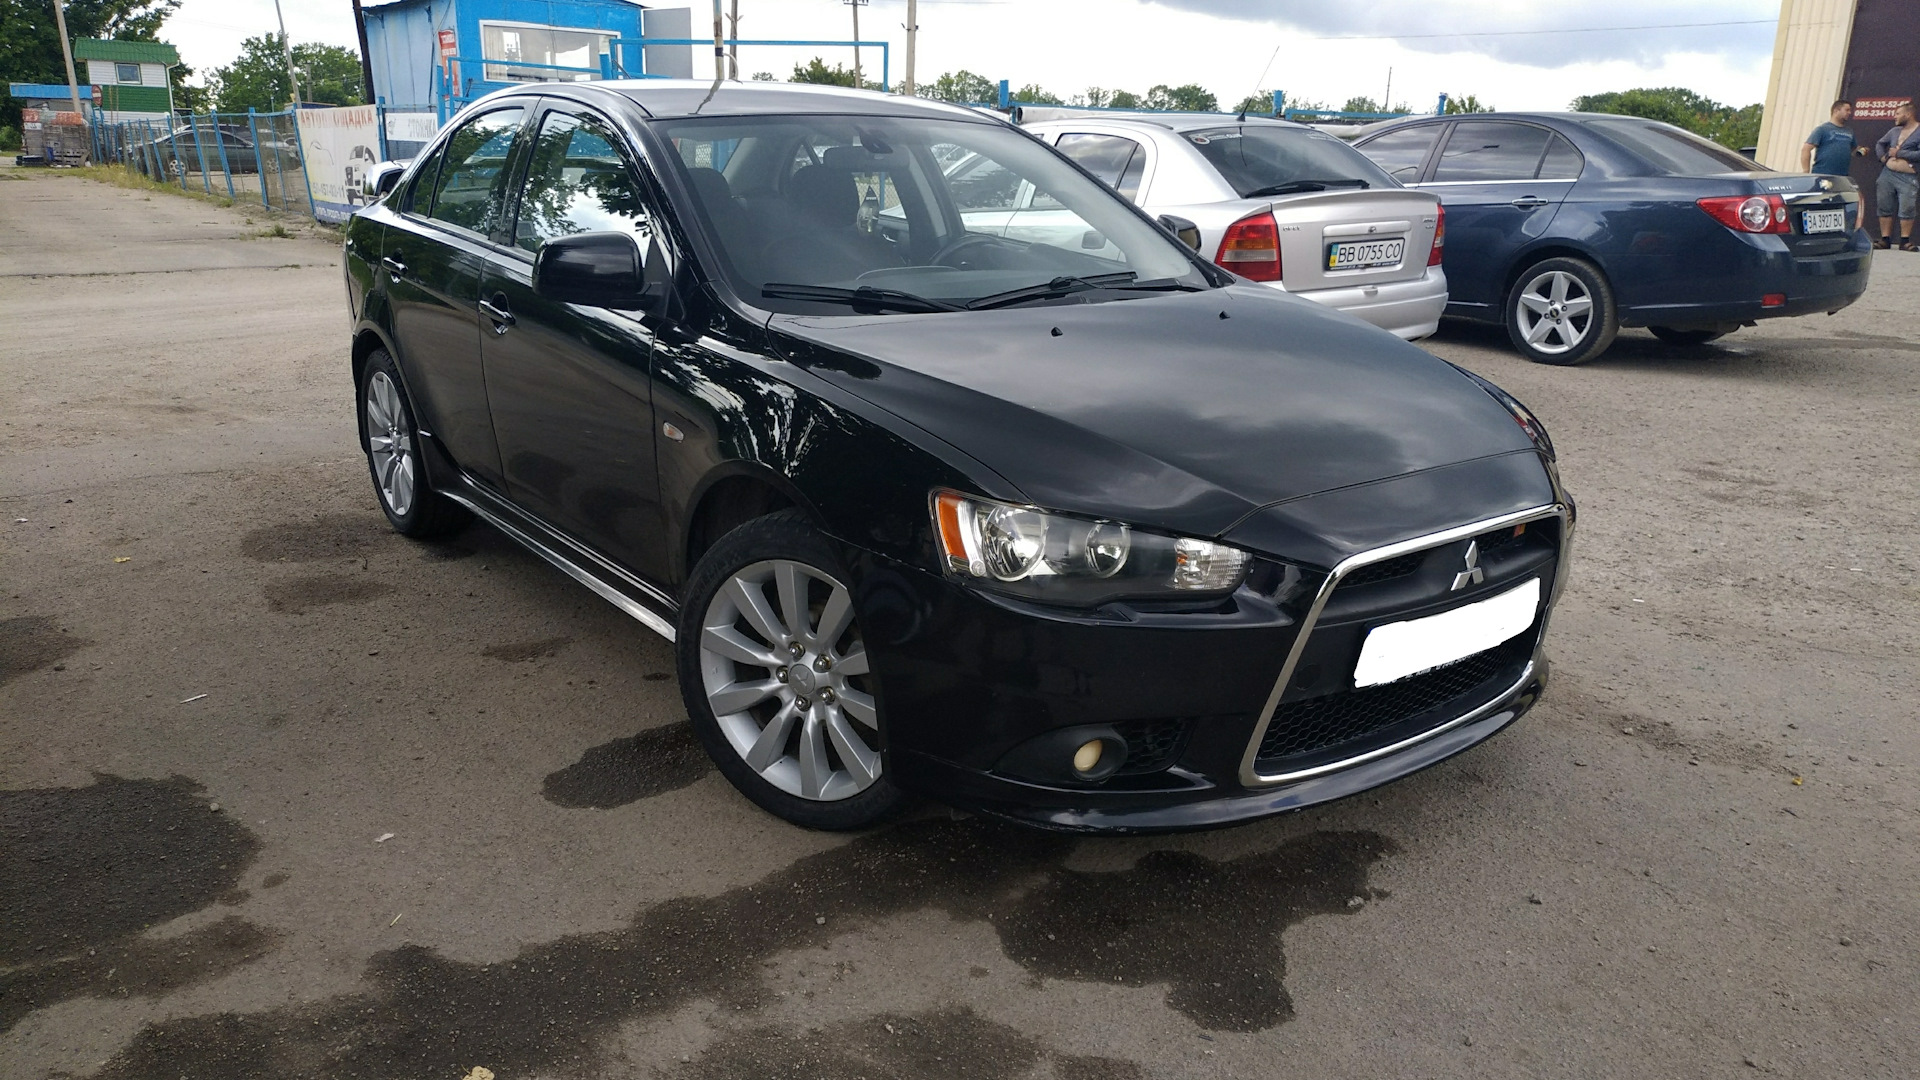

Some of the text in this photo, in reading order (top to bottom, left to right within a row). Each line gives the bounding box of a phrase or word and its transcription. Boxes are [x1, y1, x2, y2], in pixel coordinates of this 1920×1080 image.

[1855, 100, 1910, 108] 095-333-52-
[1818, 213, 1832, 228] 3927
[1338, 242, 1401, 263] BB 0755 CO
